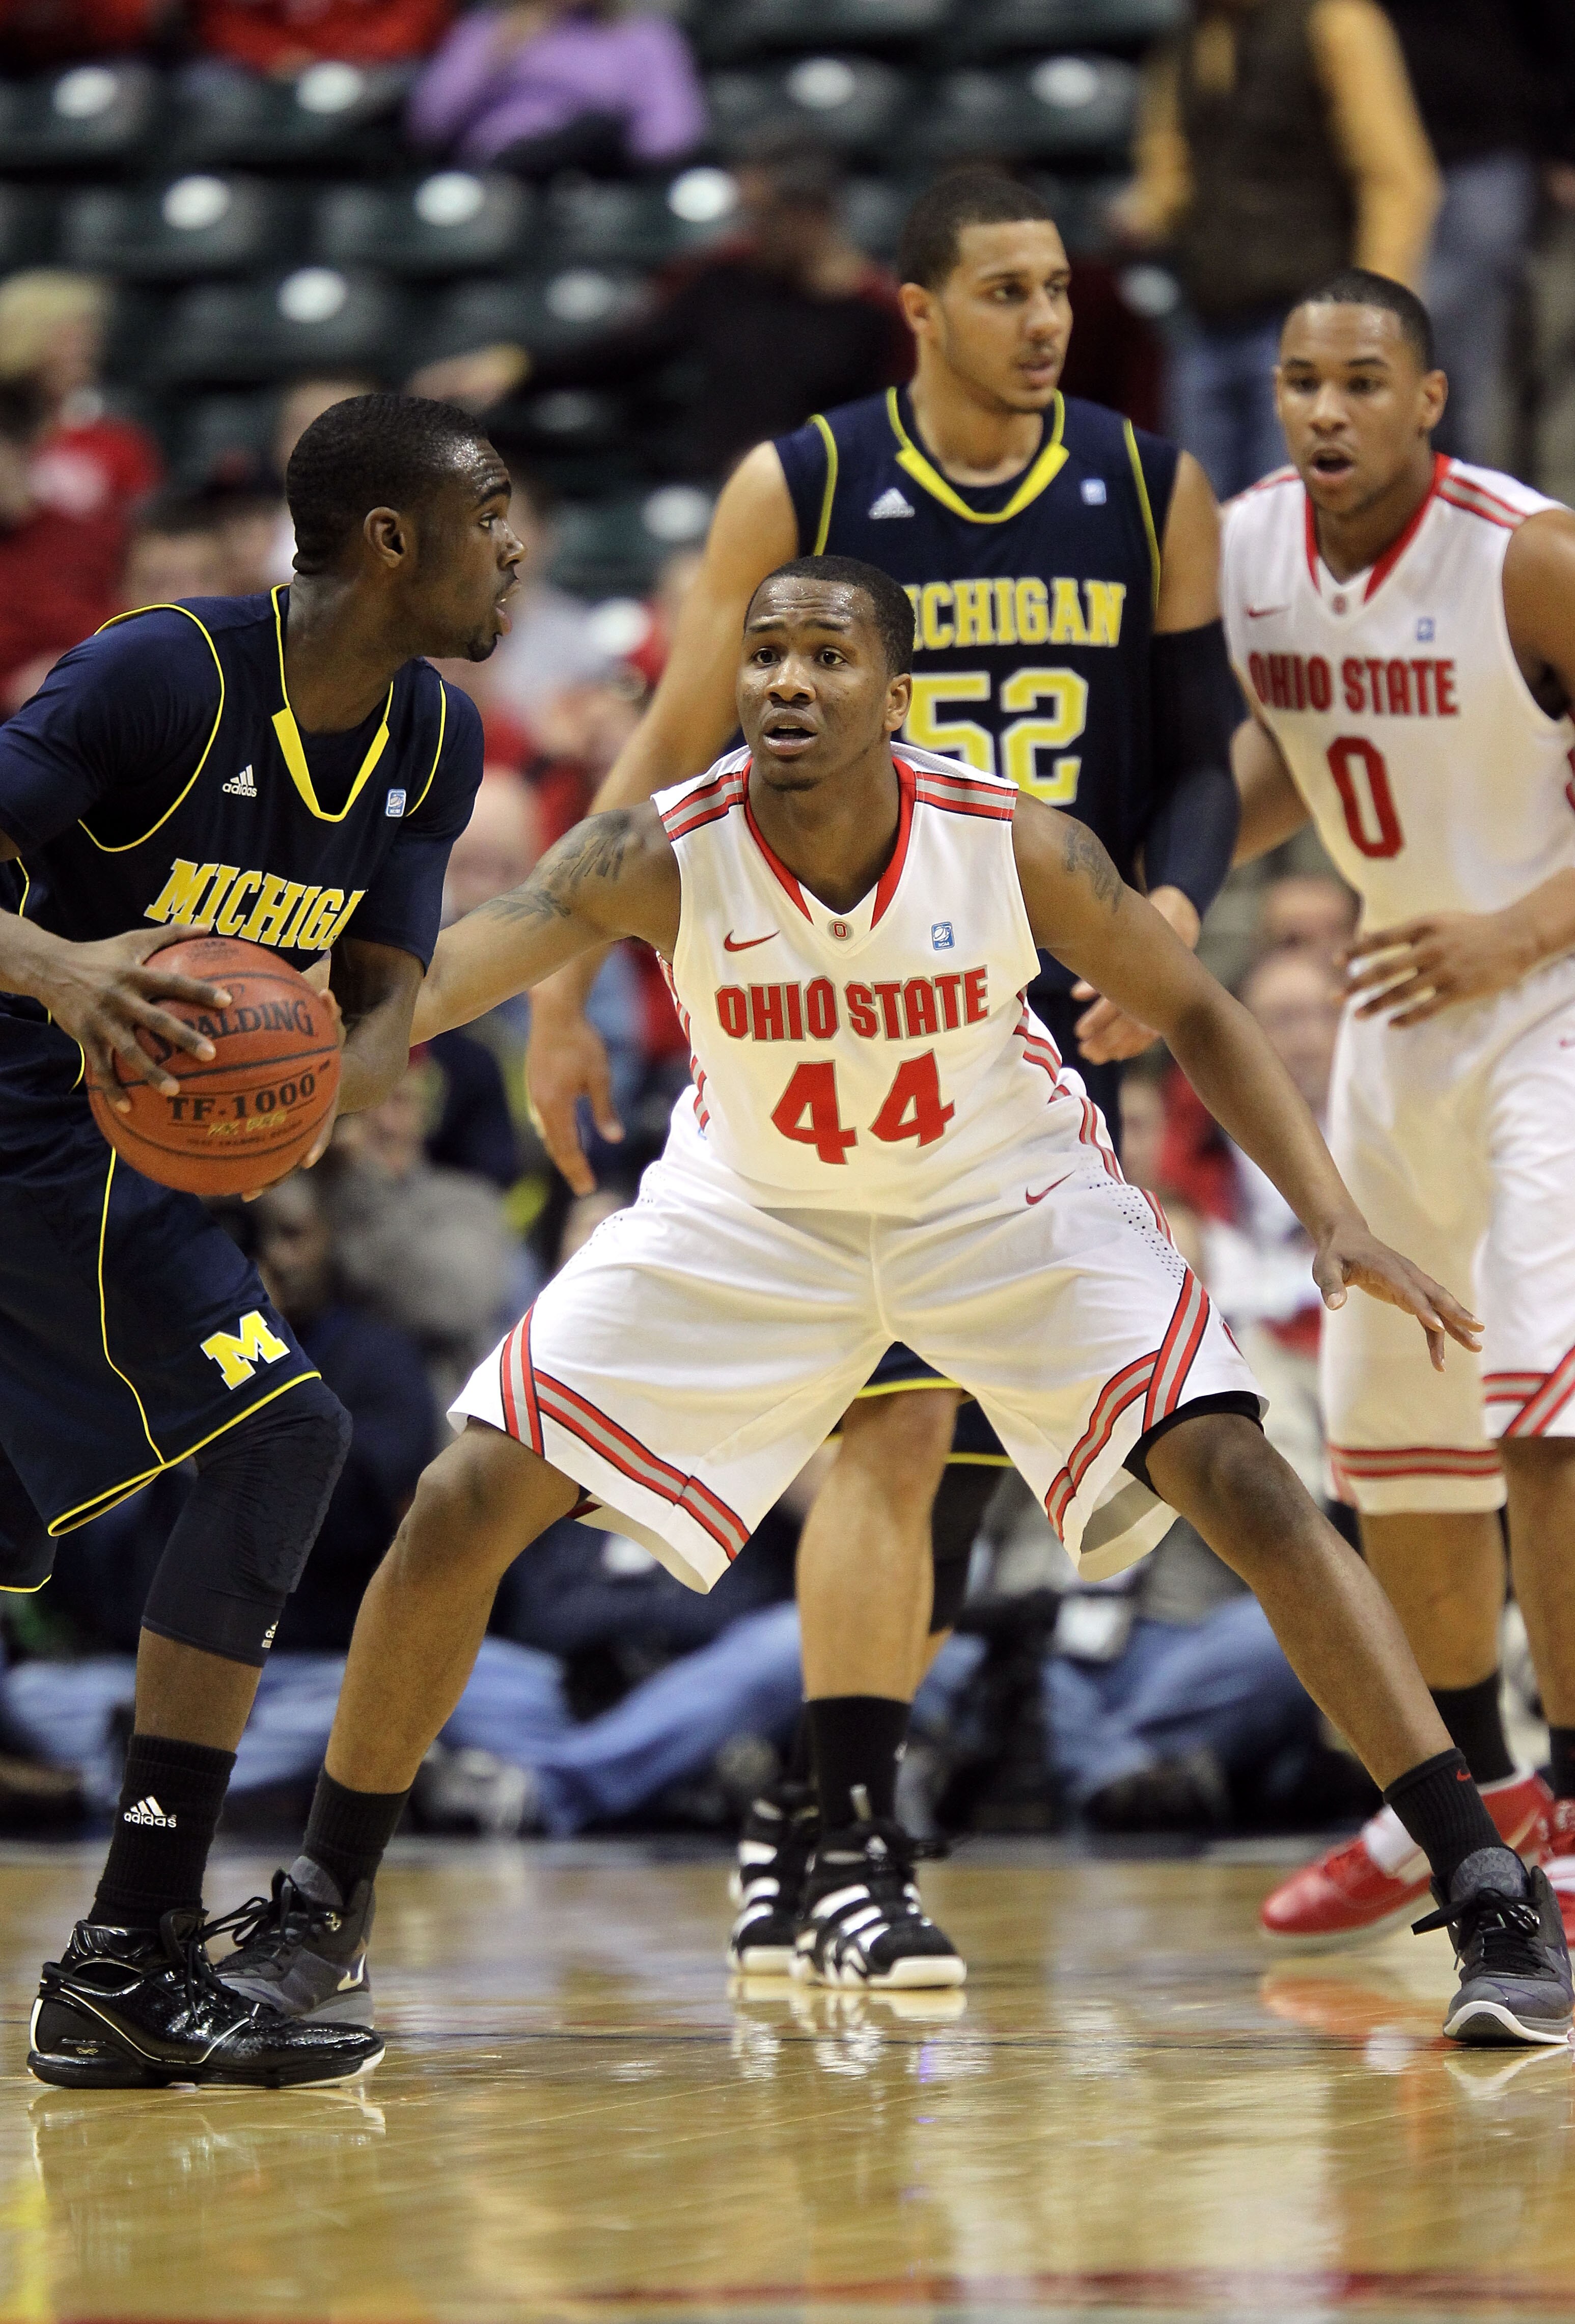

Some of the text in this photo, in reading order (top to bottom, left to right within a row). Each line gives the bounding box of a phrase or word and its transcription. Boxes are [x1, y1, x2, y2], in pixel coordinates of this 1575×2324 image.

[1248, 651, 1459, 717] OHIO STATE
[902, 667, 1089, 806] 52
[222, 783, 258, 797] adidas
[714, 964, 990, 1042] OHIO STATE
[770, 1048, 956, 1165] 44
[200, 1310, 291, 1391] M
[124, 1811, 177, 1828] adidas
